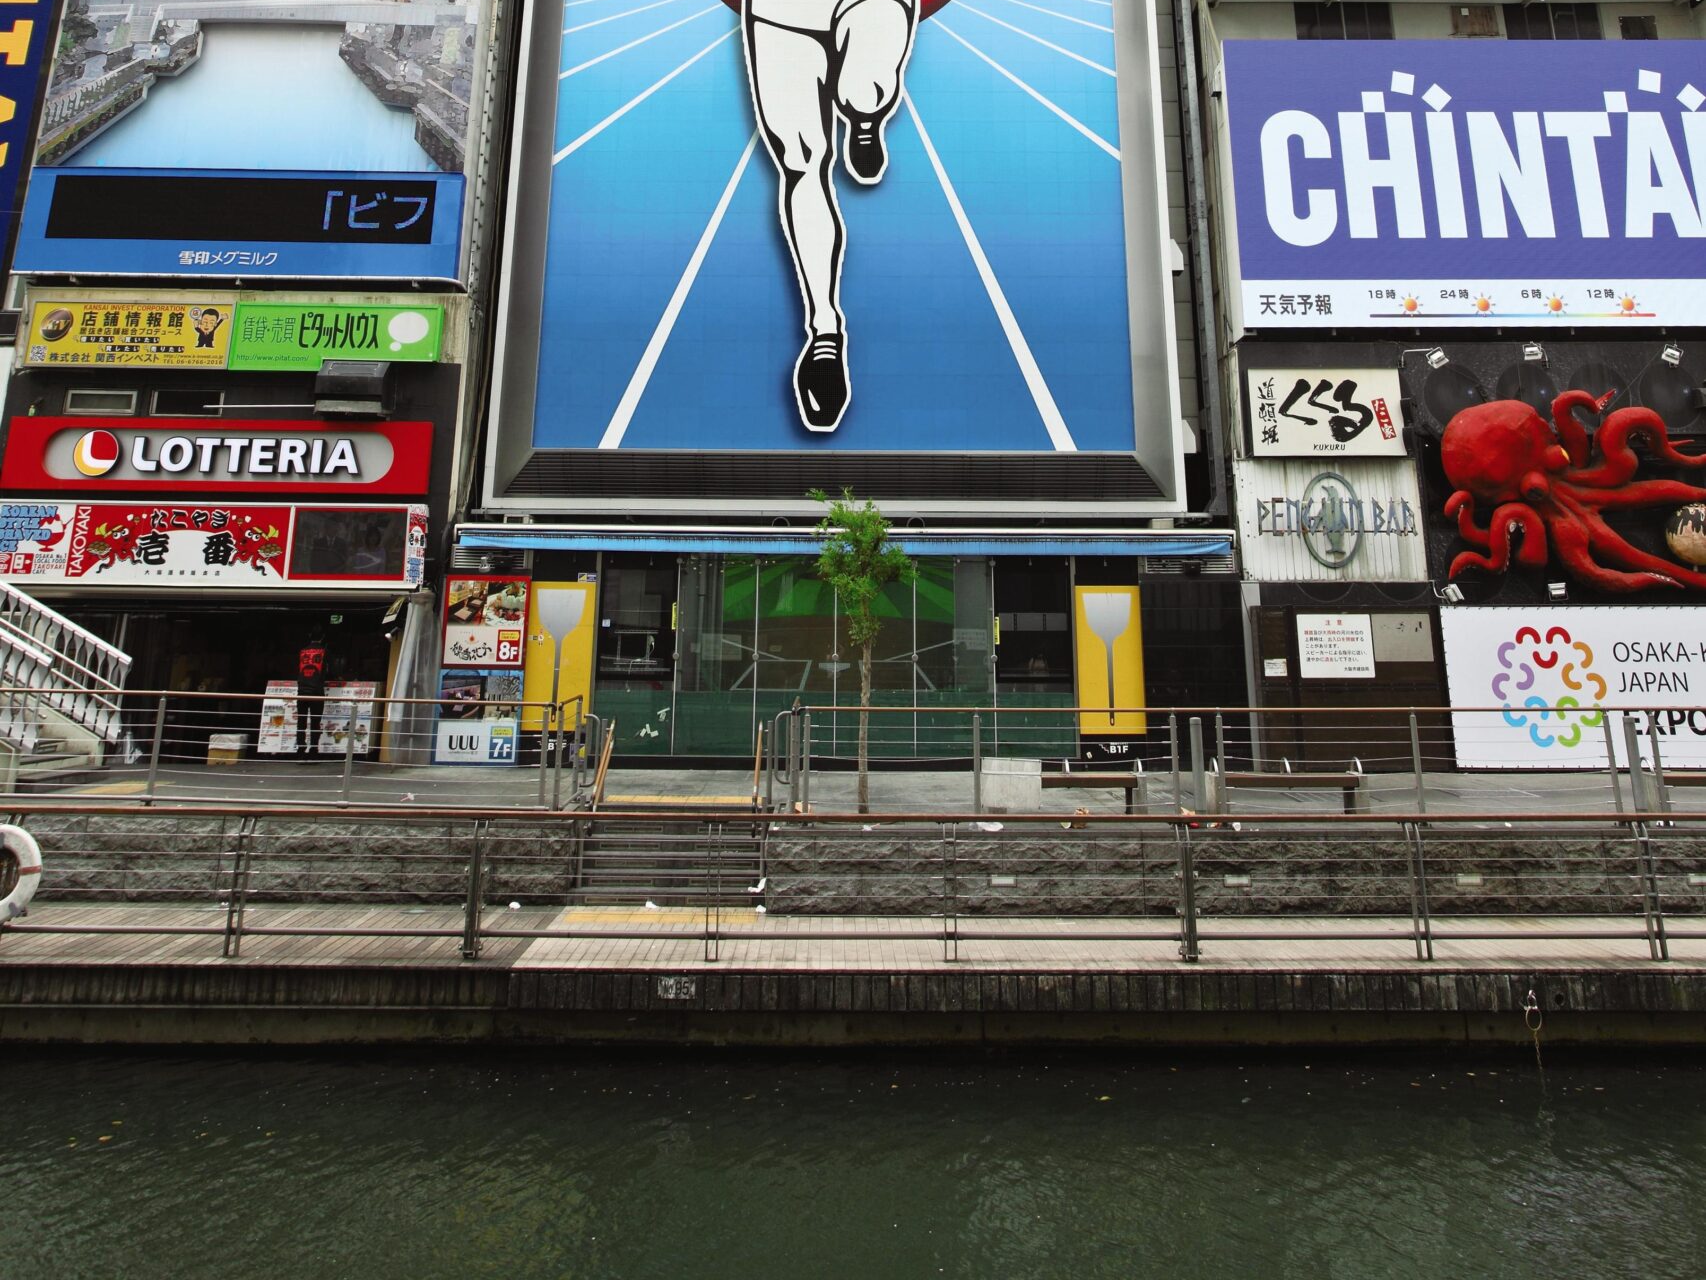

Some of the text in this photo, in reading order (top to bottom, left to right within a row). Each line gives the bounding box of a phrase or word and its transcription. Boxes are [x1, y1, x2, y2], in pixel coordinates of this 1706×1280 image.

[178, 250, 278, 267] 雪印メグミルク
[1367, 288, 1397, 300] 18時
[1439, 288, 1470, 300] 24時
[1520, 288, 1543, 300] 6時
[1586, 288, 1616, 300] 12時
[1259, 293, 1333, 316] 天気予報
[81, 311, 184, 328] 店舗情報館
[298, 311, 379, 350] ピタットハウス
[49, 352, 159, 363] 株式会社 関西インベスト
[1257, 377, 1280, 445] 道頓堀
[1278, 378, 1374, 443] くくる
[131, 435, 360, 476] LOTTERIA
[1313, 443, 1346, 451] KUKURU
[1, 505, 58, 518] KOREAN
[150, 508, 231, 529] たこやき
[1371, 497, 1419, 537] BAR
[68, 505, 92, 576] TAKOYAKI
[137, 530, 236, 567] 壱番
[498, 641, 518, 660] 8F
[1619, 672, 1689, 693] JAPAN
[491, 738, 511, 757] 7F
[1110, 745, 1129, 754] B1F
